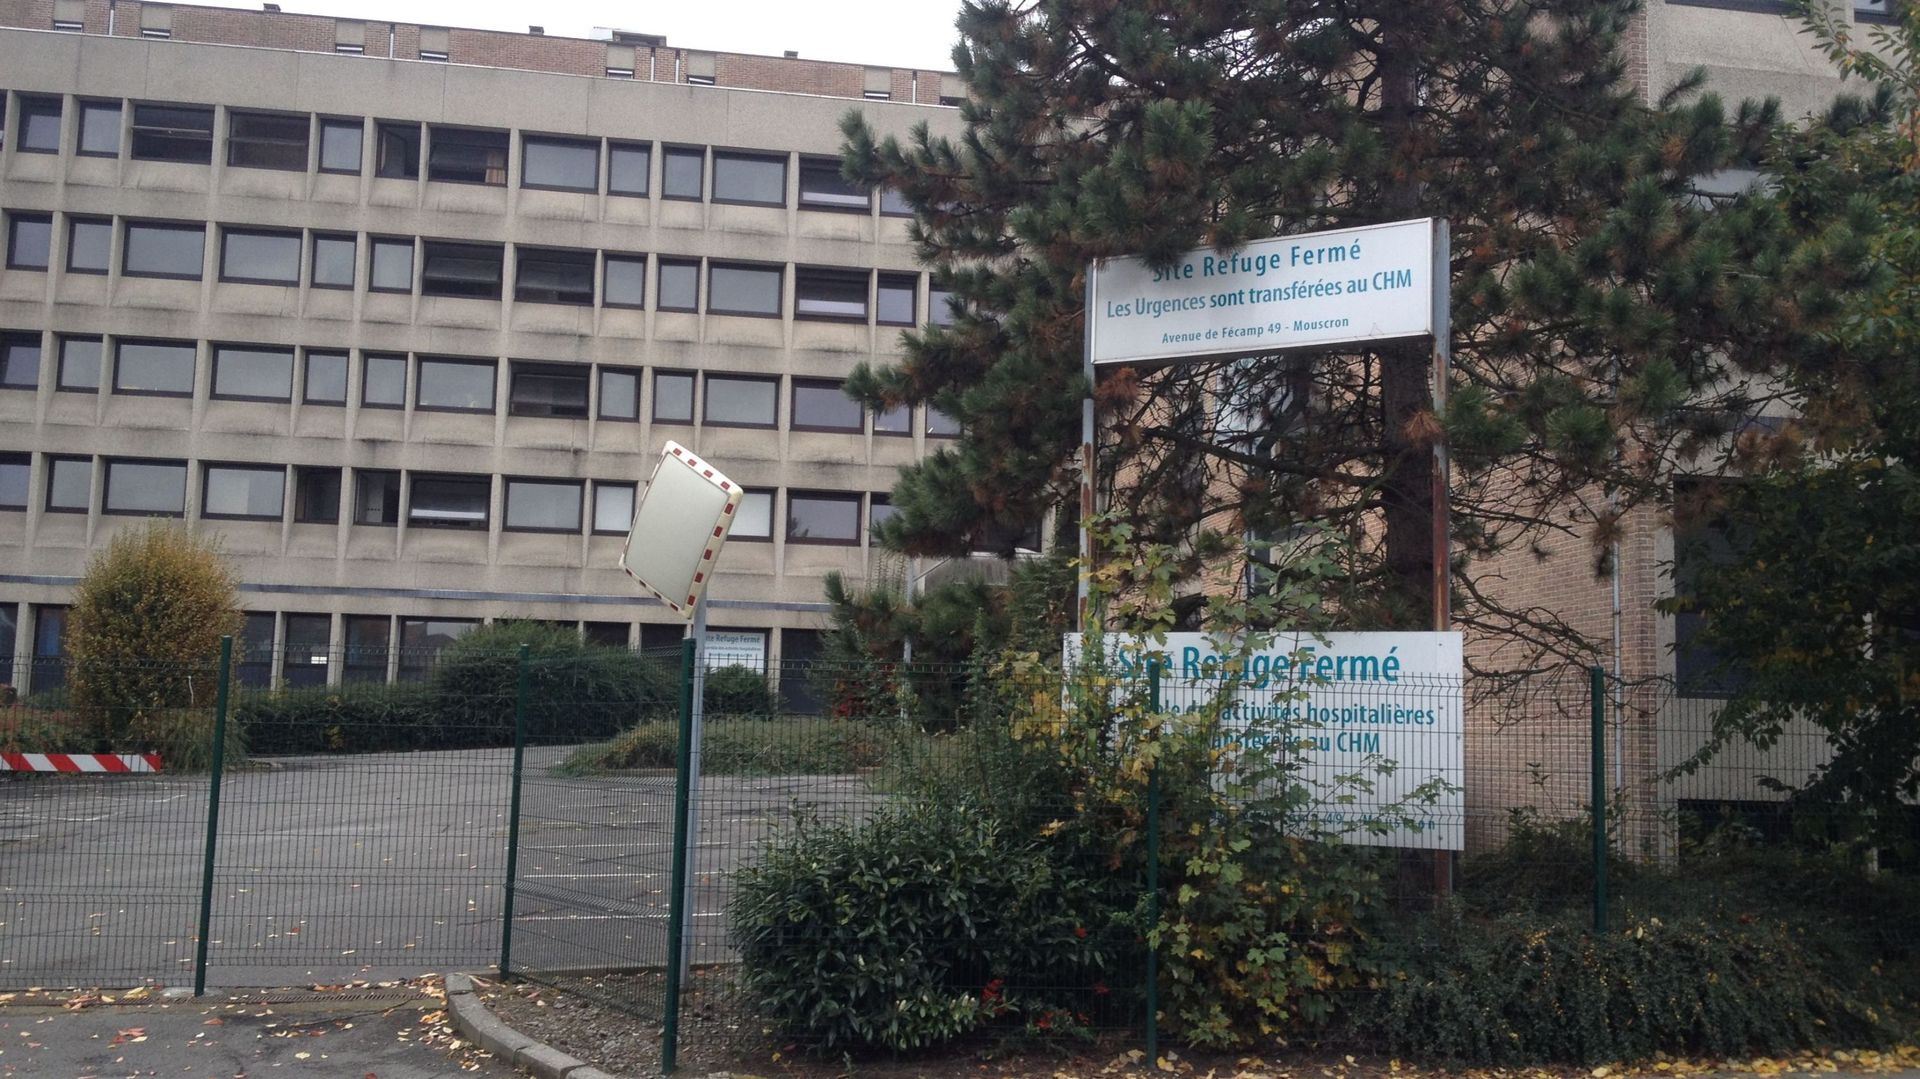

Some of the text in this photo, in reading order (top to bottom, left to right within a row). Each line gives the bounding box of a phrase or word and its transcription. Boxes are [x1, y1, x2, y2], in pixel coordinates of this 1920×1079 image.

[1203, 252, 1281, 277] Refuge
[1291, 238, 1361, 267] Fermé
[1107, 268, 1412, 318] Les Urgences sont transférées au CHM
[1162, 332, 1201, 344] Avenue
[1205, 329, 1218, 340] de
[1222, 325, 1264, 339] Fécamp
[1267, 322, 1281, 335] 49
[1293, 317, 1349, 332] Mouscron
[1299, 646, 1400, 682] Fermé
[1307, 702, 1435, 728] hospitalières
[1337, 731, 1380, 753] CHM
